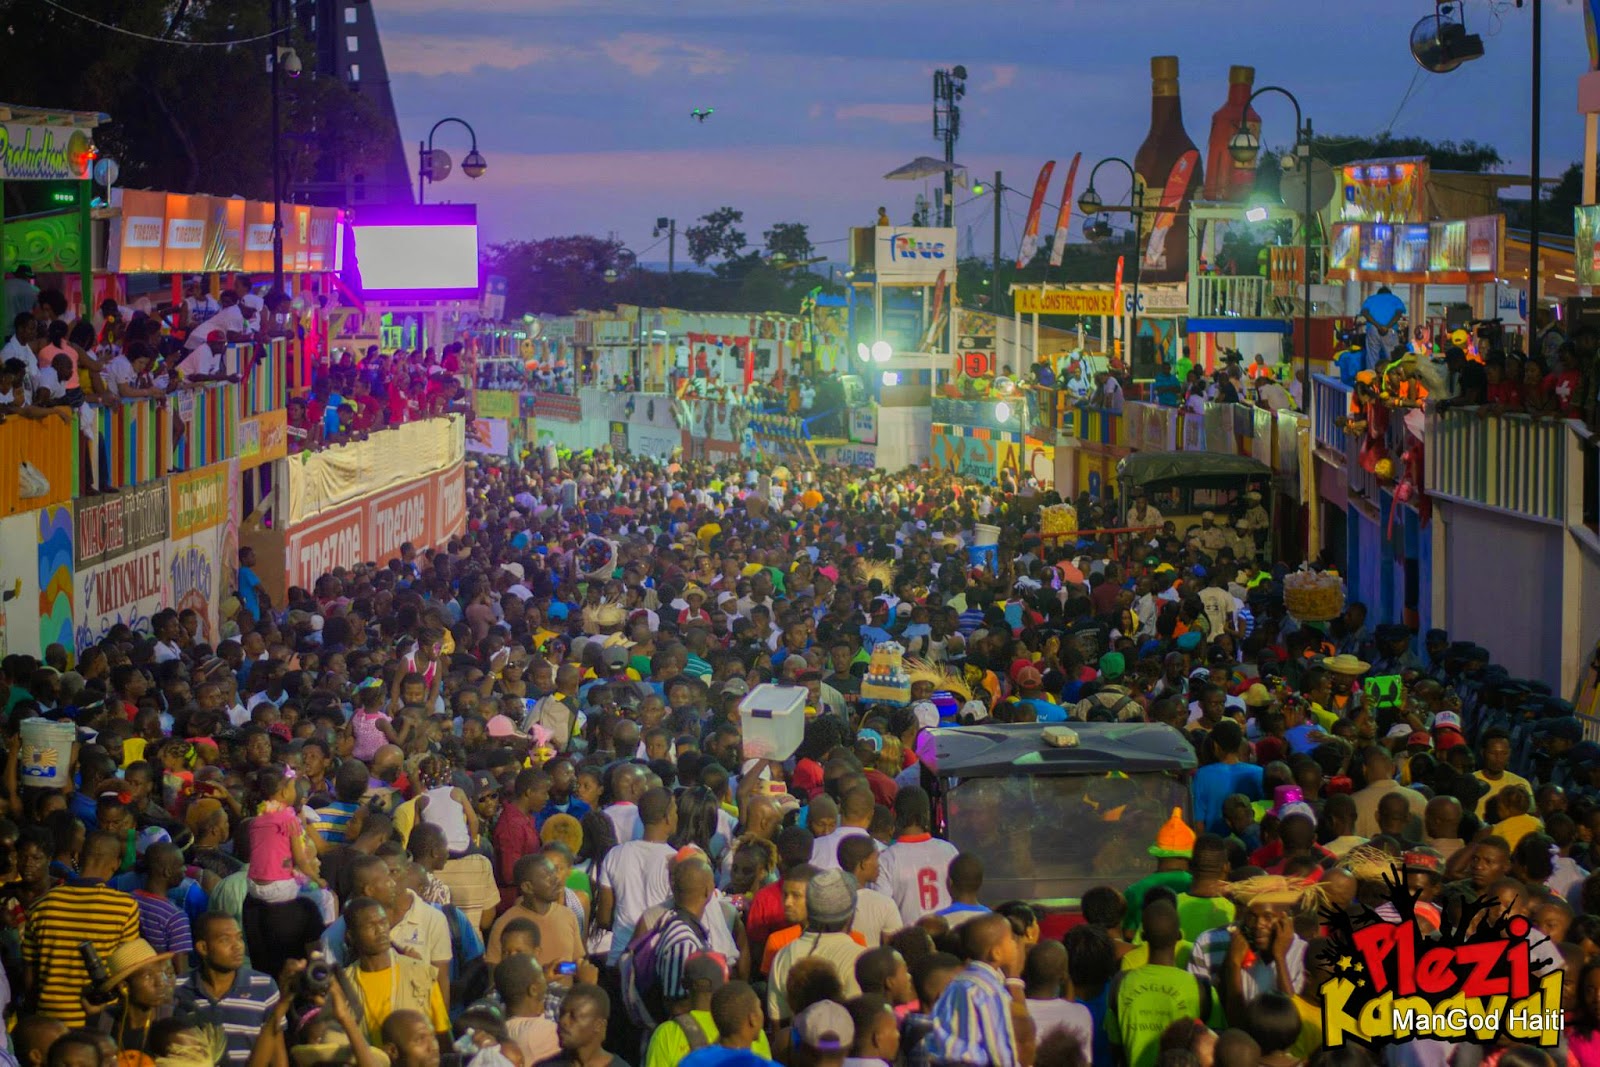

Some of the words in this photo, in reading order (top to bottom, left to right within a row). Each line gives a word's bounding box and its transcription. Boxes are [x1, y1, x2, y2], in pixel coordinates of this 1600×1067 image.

[1040, 294, 1100, 312] CONSTRUCTION
[96, 550, 161, 616] NATIONALE
[916, 866, 939, 910] 6
